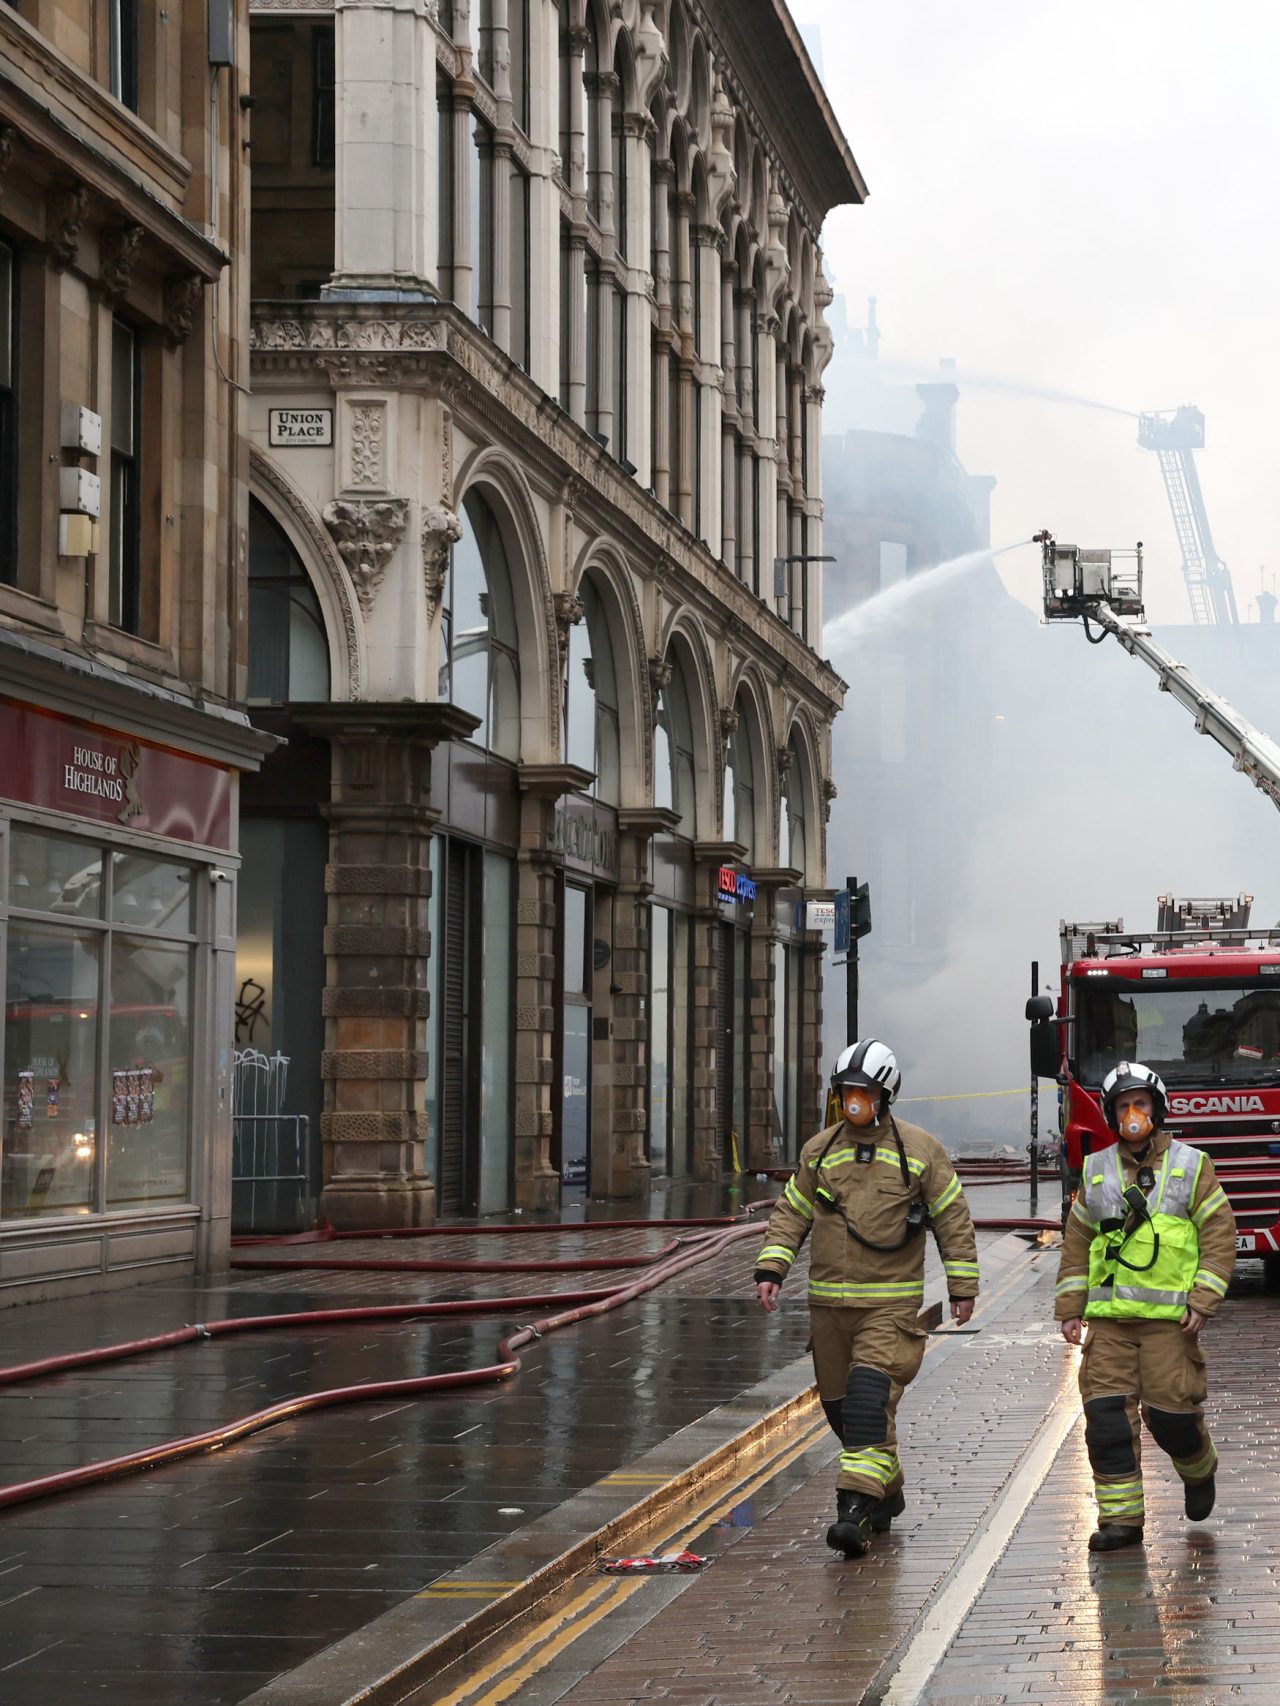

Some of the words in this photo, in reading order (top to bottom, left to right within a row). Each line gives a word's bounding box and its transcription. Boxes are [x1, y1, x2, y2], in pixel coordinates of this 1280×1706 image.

[73, 746, 104, 771] HOUSE
[104, 756, 118, 775] OF
[719, 867, 737, 894] TESCO
[1171, 1096, 1265, 1114] SCANIA
